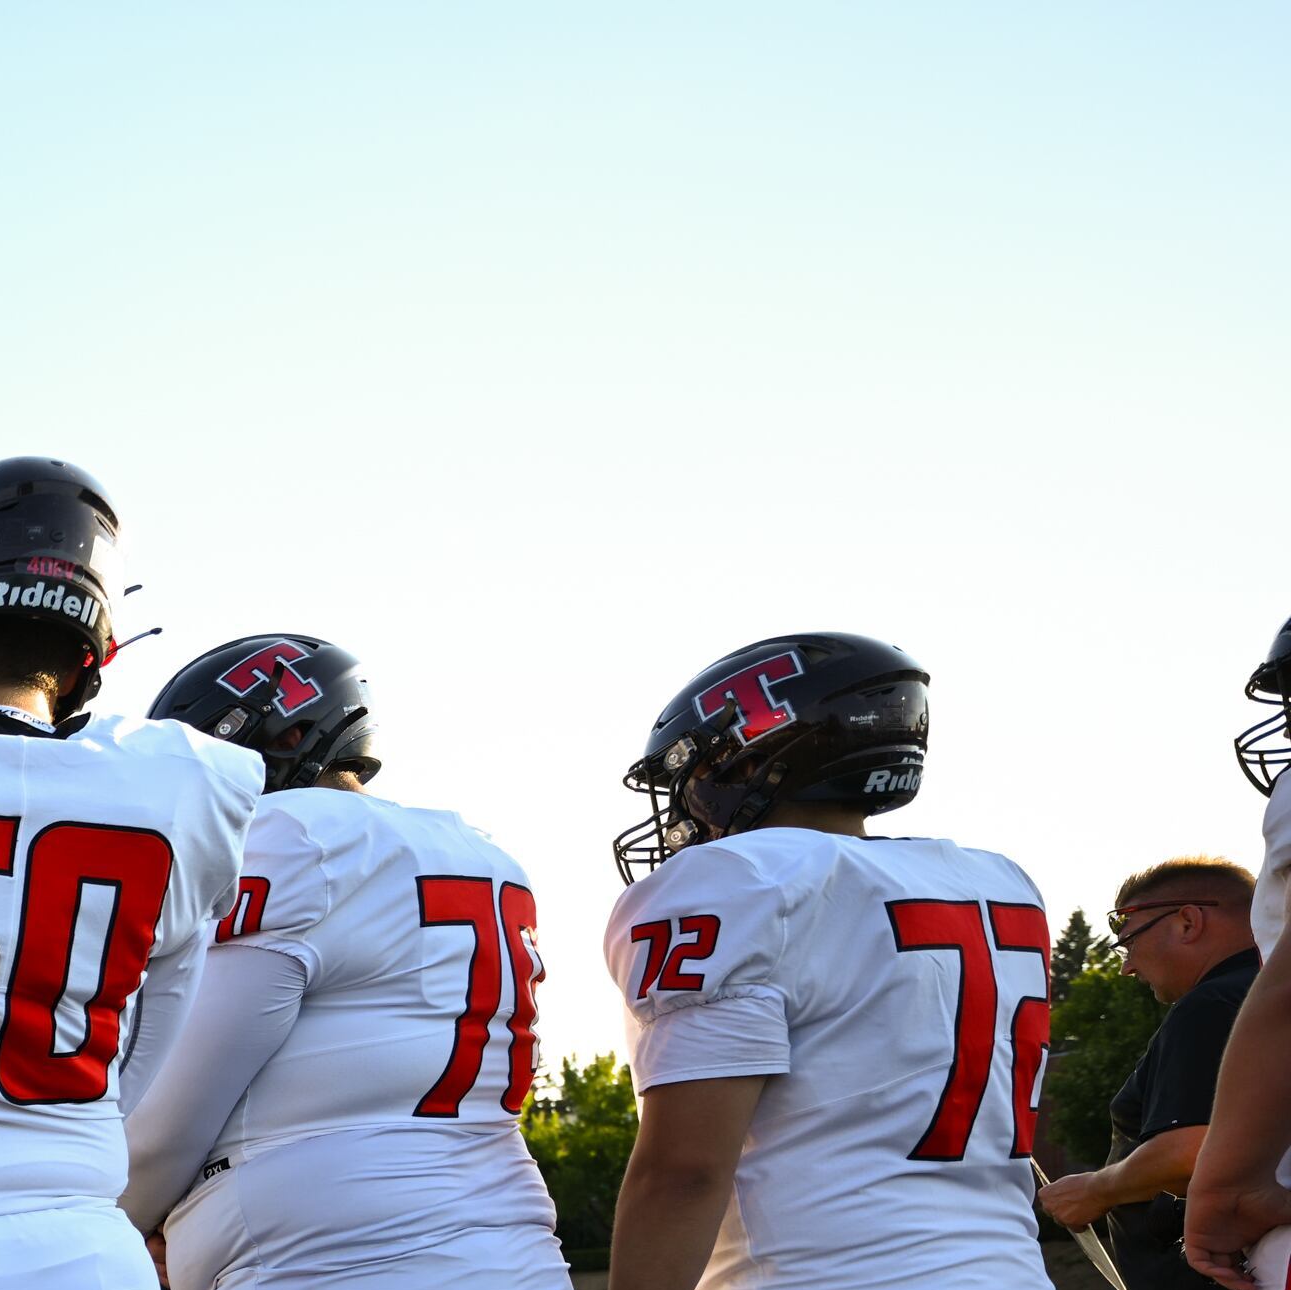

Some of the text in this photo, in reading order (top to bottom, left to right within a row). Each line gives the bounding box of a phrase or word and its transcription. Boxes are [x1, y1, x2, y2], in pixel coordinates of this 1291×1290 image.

[693, 650, 804, 748] T
[863, 768, 922, 794] Ridd
[630, 914, 721, 1000] 72
[883, 899, 1052, 1162] 72
